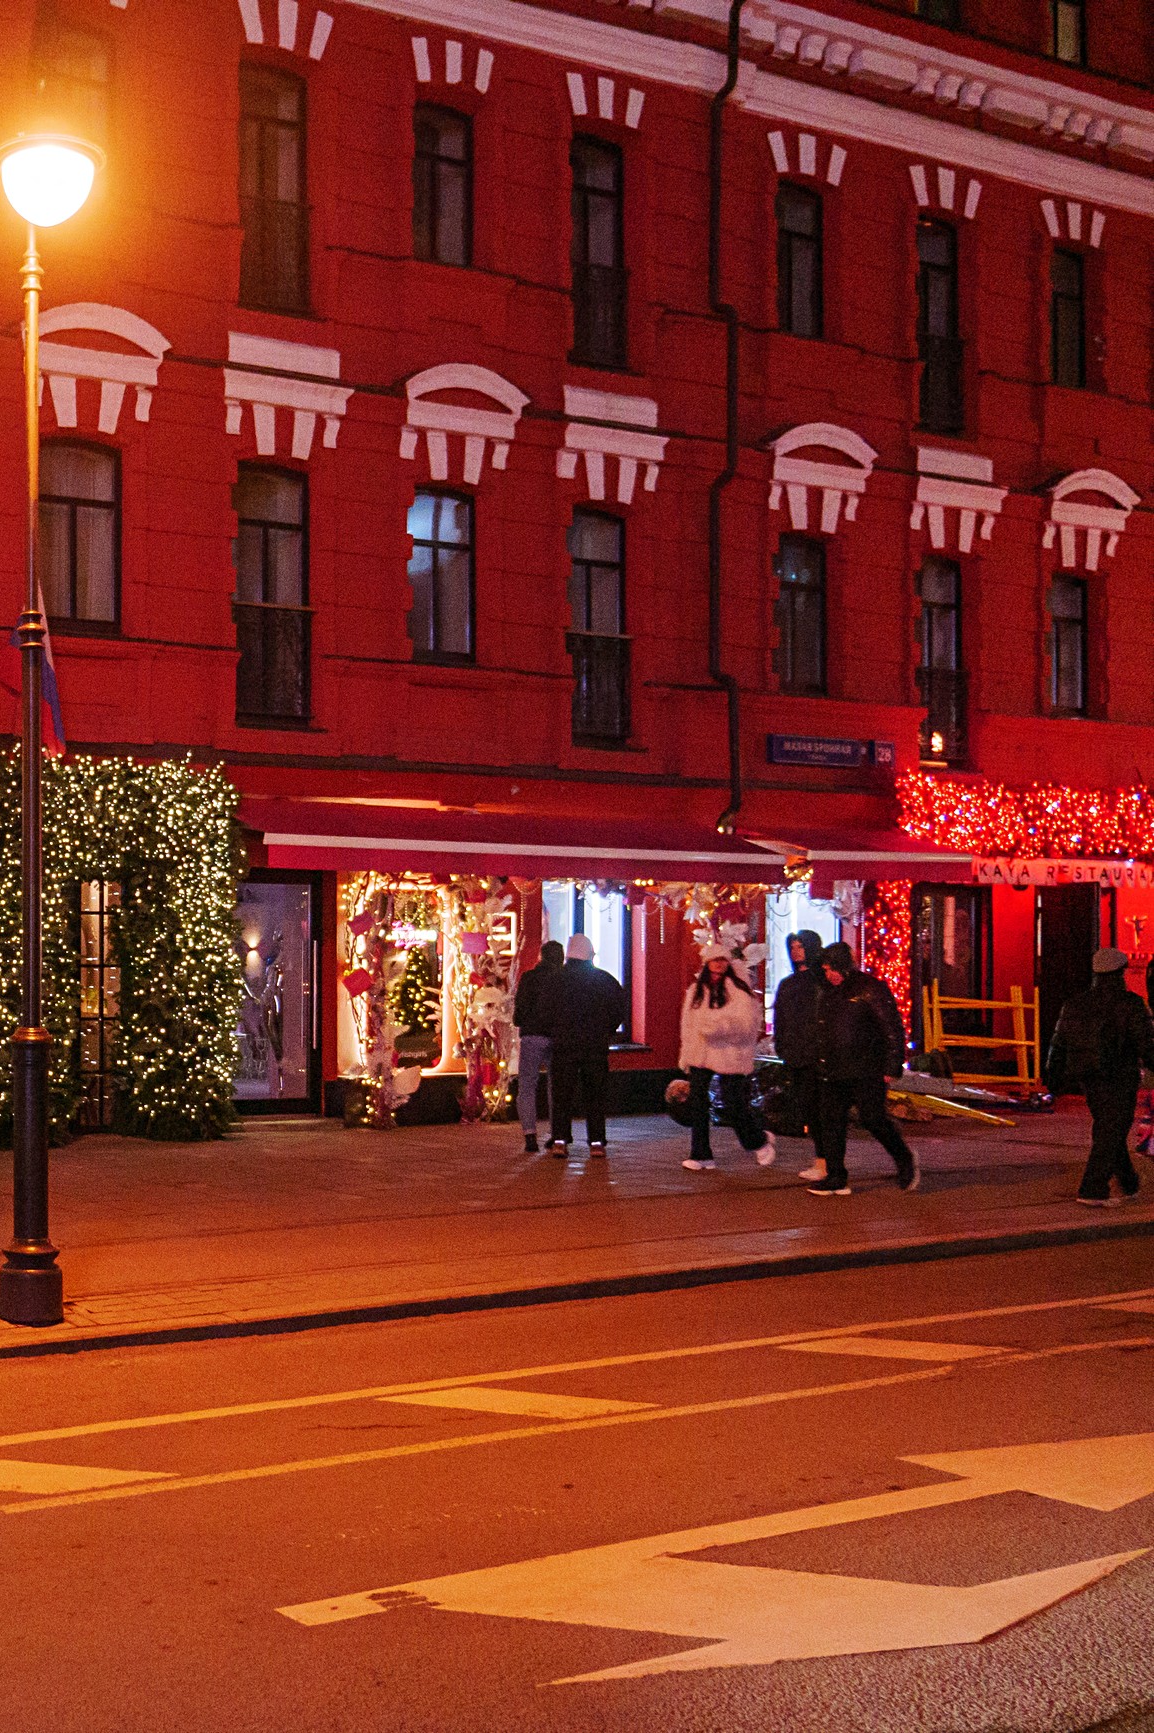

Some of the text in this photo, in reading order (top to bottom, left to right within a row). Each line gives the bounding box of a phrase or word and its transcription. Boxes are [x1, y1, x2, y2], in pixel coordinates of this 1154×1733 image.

[878, 747, 892, 762] 28
[978, 863, 1154, 883] KAYA RESTAURA
